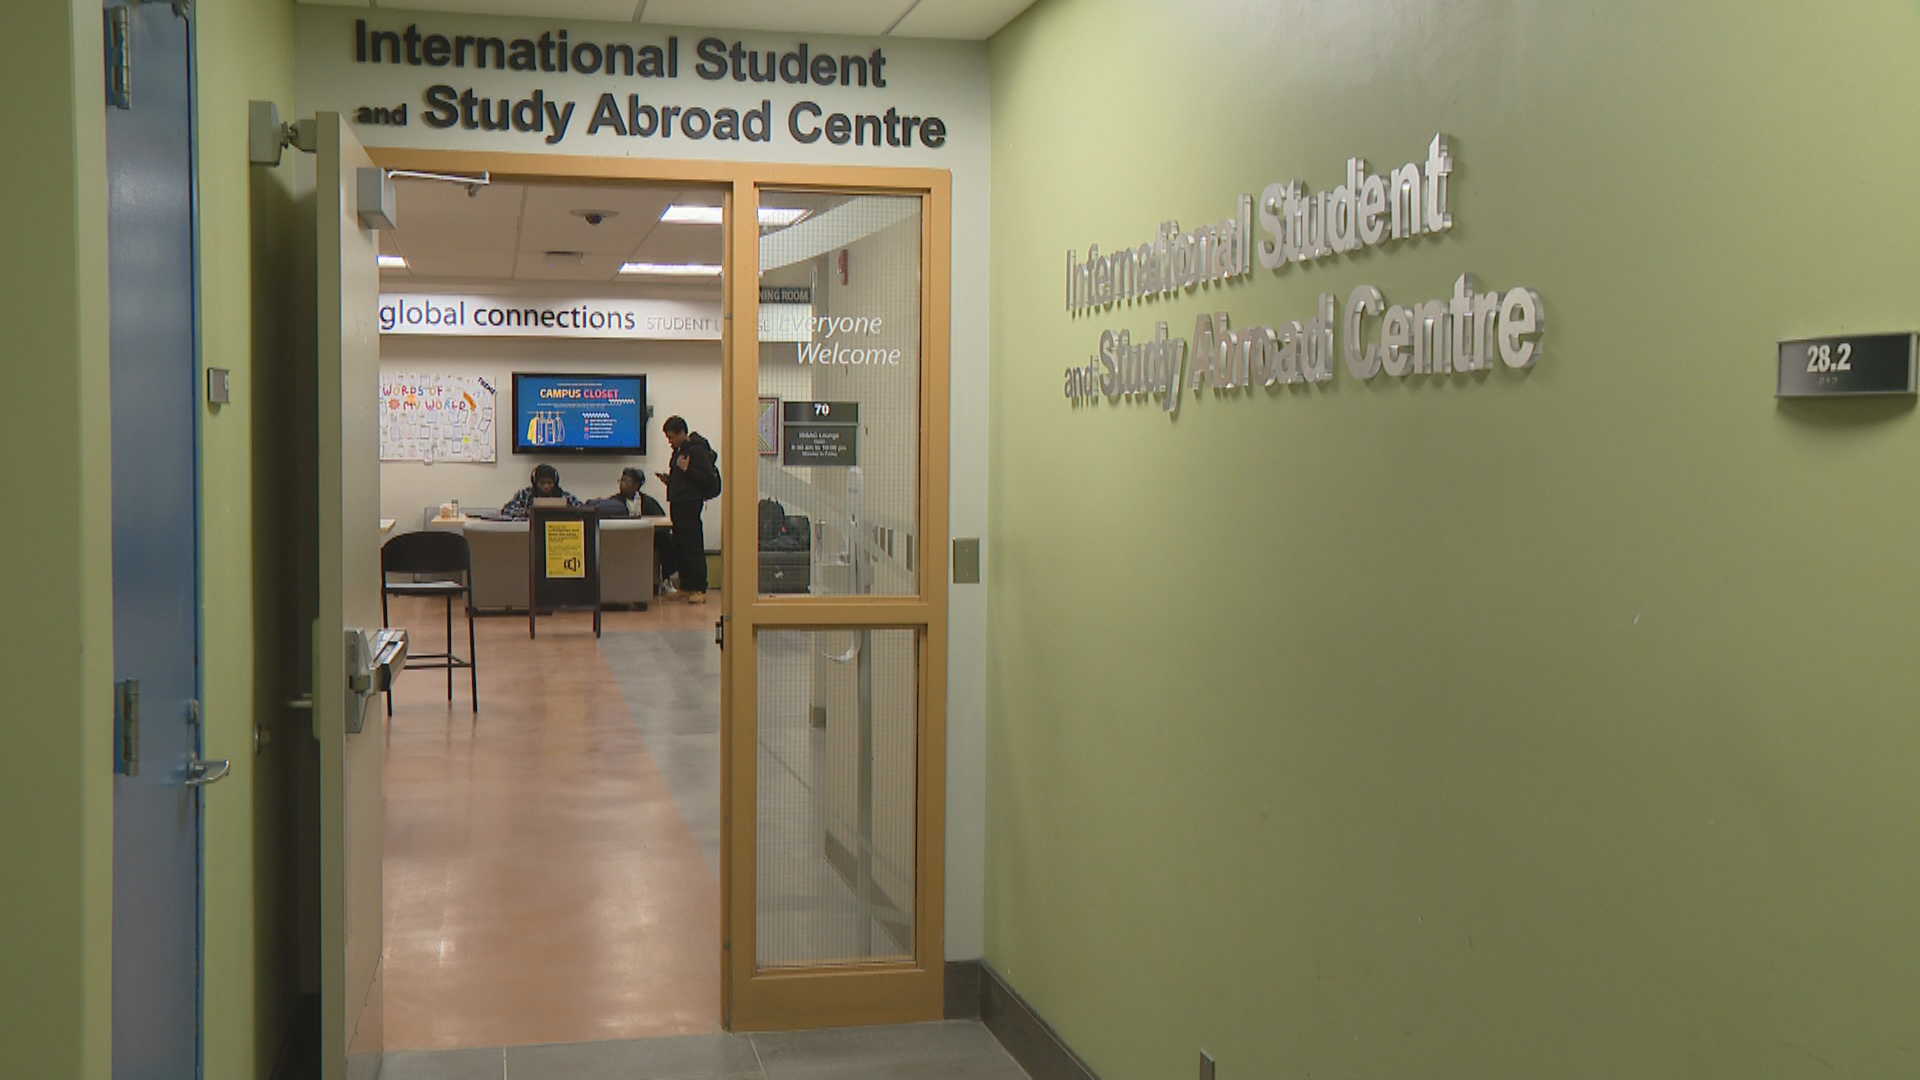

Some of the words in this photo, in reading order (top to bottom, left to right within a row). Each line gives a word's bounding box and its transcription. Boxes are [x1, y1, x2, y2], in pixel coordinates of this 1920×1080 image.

[355, 19, 679, 78] International
[696, 37, 887, 87] Student
[357, 103, 407, 126] and
[425, 85, 575, 144] Study
[587, 93, 771, 142] Abroad
[788, 102, 948, 149] Centre
[1065, 193, 1253, 314] International
[1258, 132, 1455, 270] Student
[782, 289, 809, 302] ROOM
[380, 299, 465, 330] global
[473, 306, 636, 330] connections
[647, 317, 711, 331] STUDENT
[779, 313, 883, 339] Everyone
[797, 342, 902, 366] Welcome
[1064, 355, 1099, 405] and
[1098, 321, 1185, 414] Study
[1187, 293, 1336, 391] Abroad
[1343, 271, 1545, 380] Centre
[1806, 343, 1852, 373] 28.2
[382, 384, 424, 396] WORDS
[429, 386, 443, 396] OF
[540, 389, 581, 399] CAMPUS
[583, 389, 619, 399] CLOSET
[403, 401, 420, 410] MY
[425, 400, 466, 410] WORLD
[814, 403, 830, 416] 70
